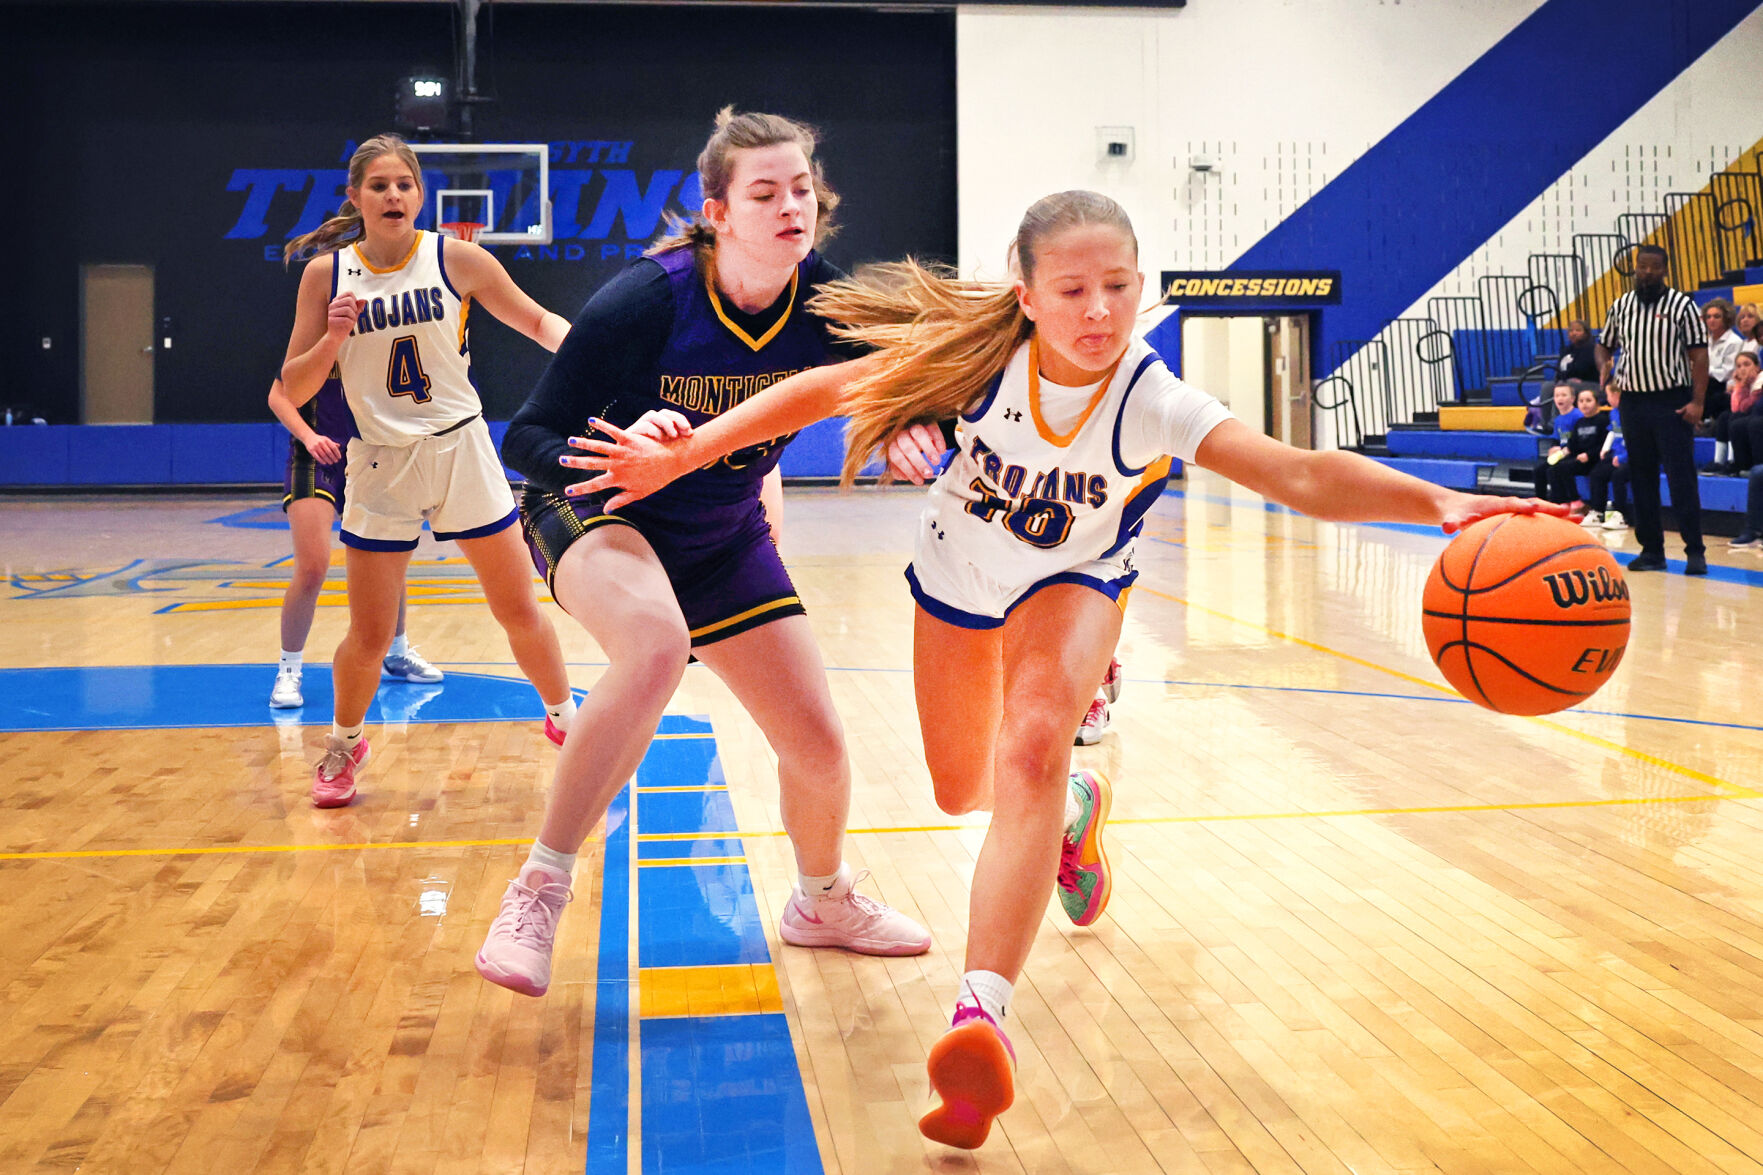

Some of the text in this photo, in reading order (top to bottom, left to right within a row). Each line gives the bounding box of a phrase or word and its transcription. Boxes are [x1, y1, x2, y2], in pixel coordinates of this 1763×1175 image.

[513, 244, 585, 261] AND
[349, 286, 445, 336] ROJANS
[1170, 278, 1333, 296] CONCESSIONS
[386, 334, 433, 405] 4
[970, 434, 1109, 509] TROJANS
